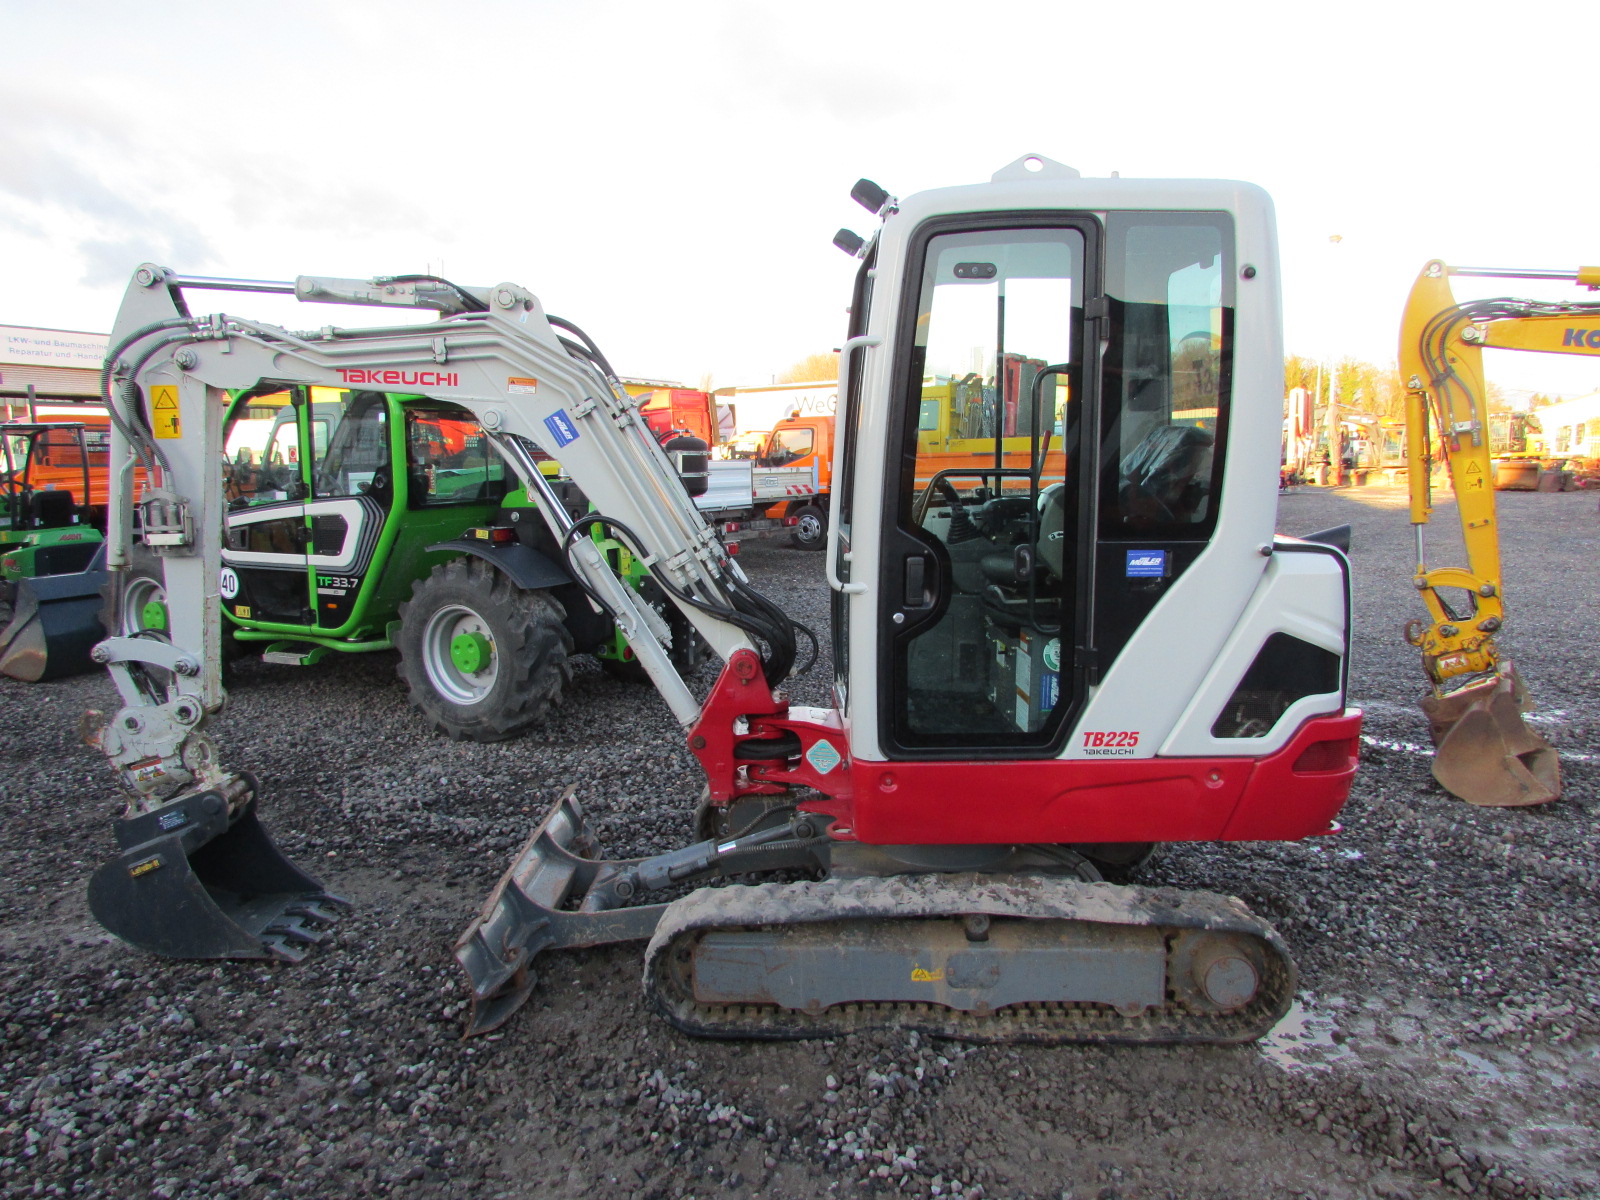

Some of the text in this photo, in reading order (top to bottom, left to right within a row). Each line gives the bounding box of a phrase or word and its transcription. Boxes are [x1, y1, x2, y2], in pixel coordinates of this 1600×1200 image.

[8, 336, 31, 345] LKW-
[9, 347, 52, 356] Reparatur
[55, 351, 71, 359] und
[221, 574, 236, 593] 40
[317, 576, 359, 588] TF33.7
[1083, 731, 1140, 747] TB225
